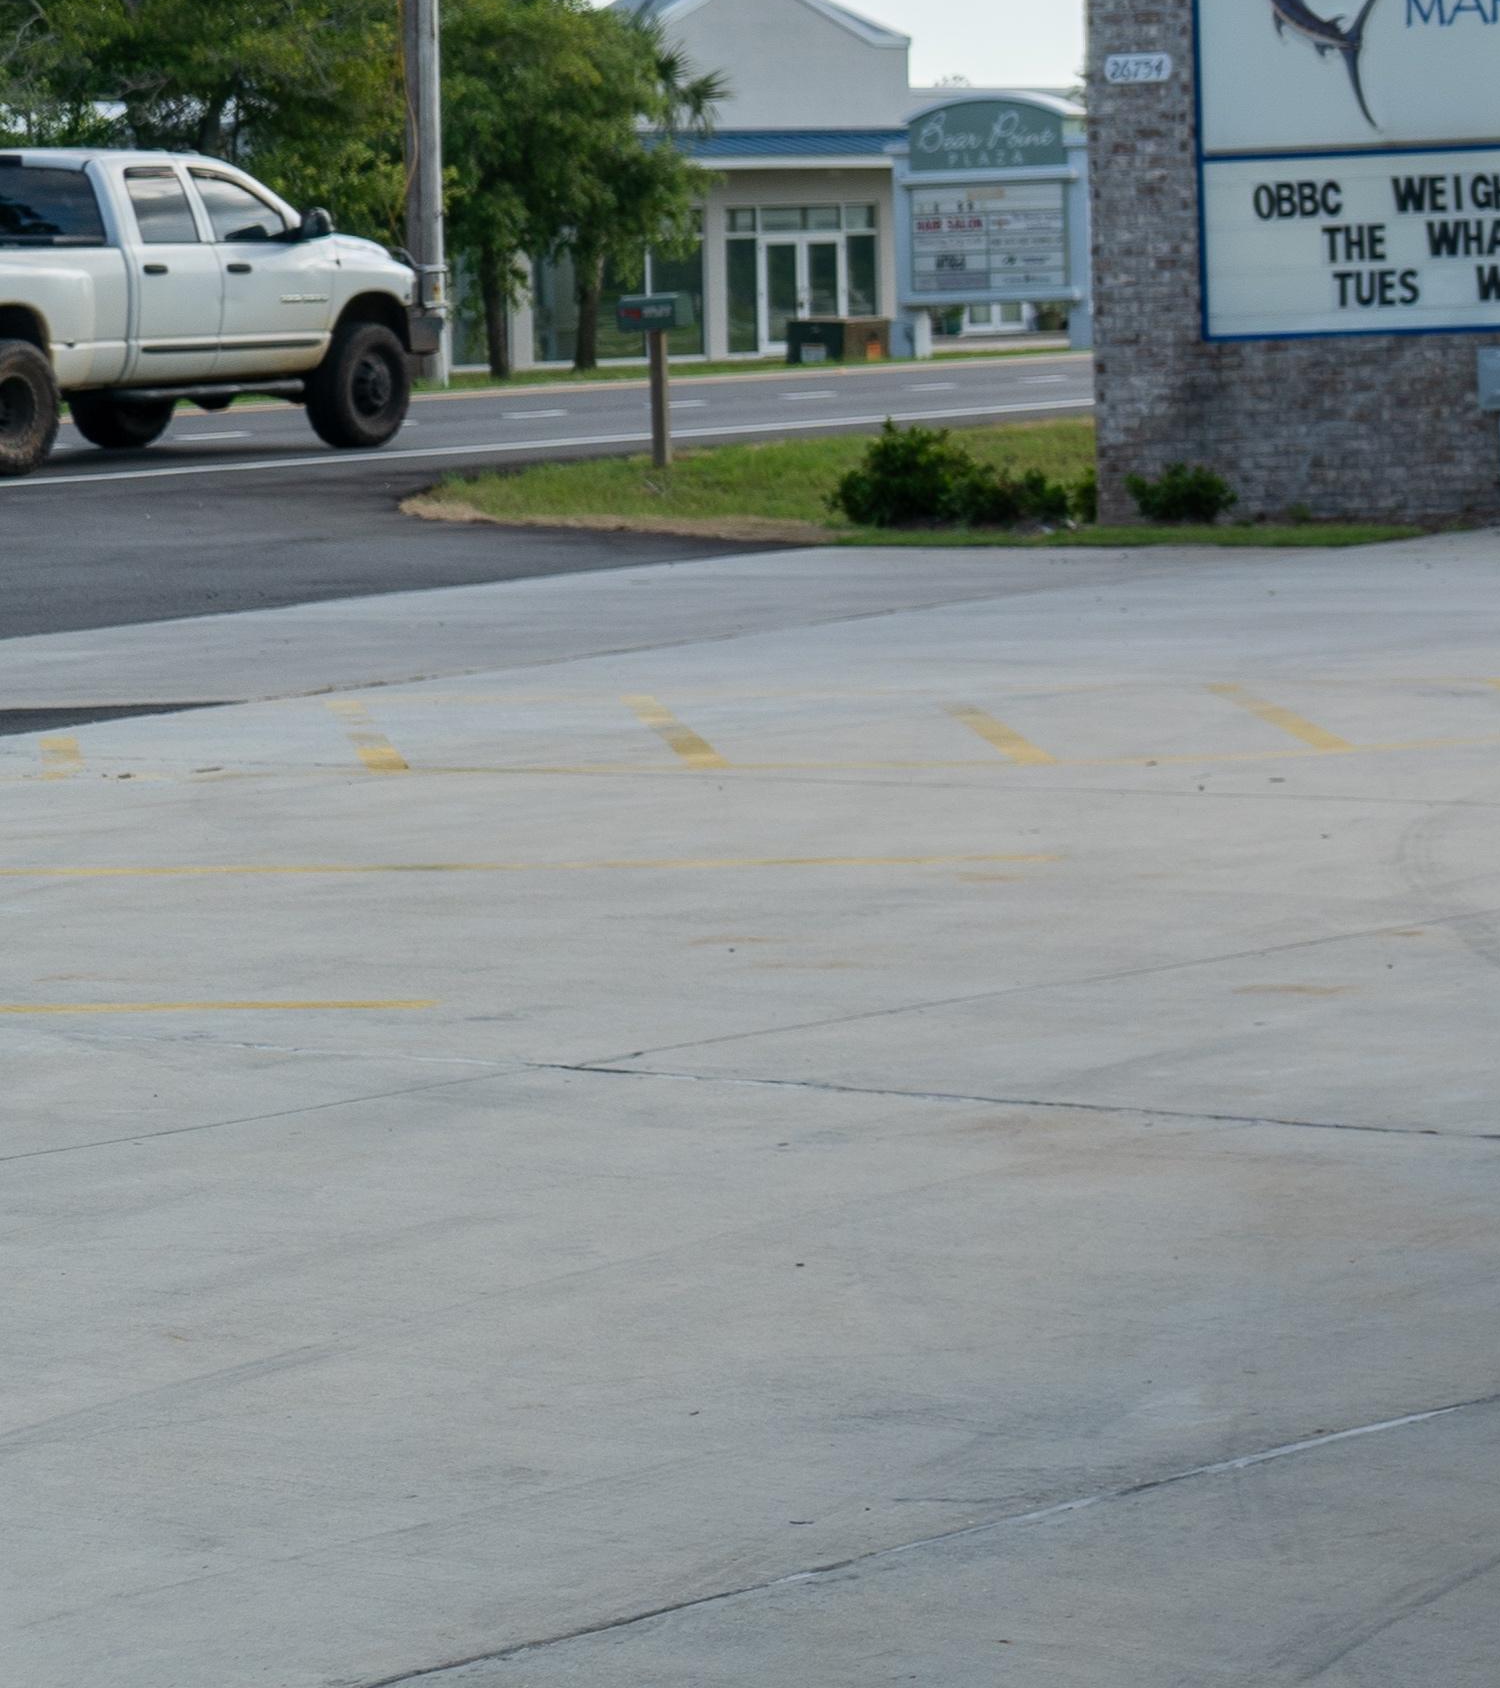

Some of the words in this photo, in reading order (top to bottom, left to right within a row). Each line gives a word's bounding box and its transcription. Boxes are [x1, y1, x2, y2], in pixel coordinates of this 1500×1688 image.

[986, 110, 1056, 152] Point
[1253, 179, 1344, 221] OBBC
[1321, 223, 1387, 264] THE
[1333, 268, 1420, 309] TUES
